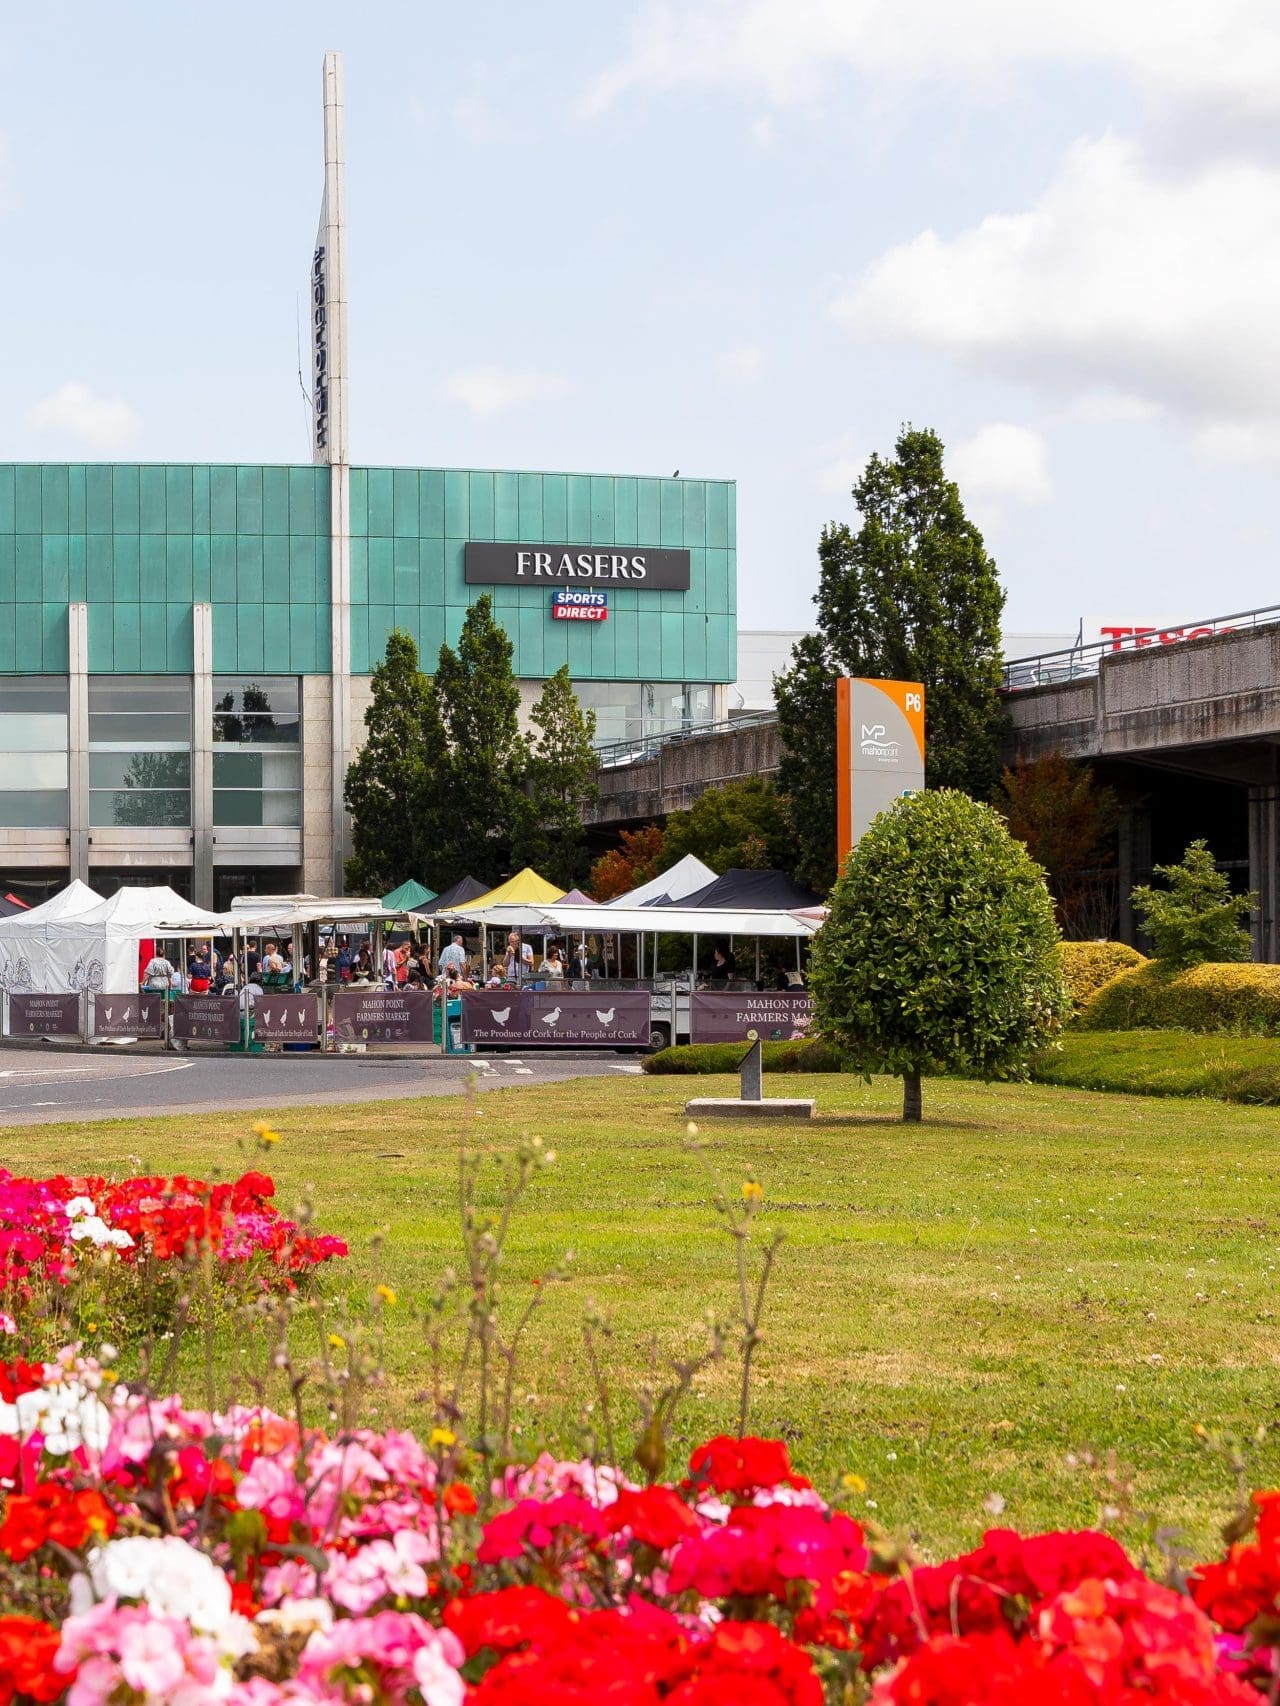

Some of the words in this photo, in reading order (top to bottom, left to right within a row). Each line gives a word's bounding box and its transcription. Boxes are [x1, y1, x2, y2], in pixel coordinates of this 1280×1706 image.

[516, 552, 646, 579] FRASERS
[557, 592, 605, 605] SPORTS
[557, 607, 604, 619] DIRECT
[905, 692, 921, 713] P6
[362, 1000, 384, 1008] MAHON
[386, 1000, 405, 1008] POINT
[747, 1000, 790, 1009] MAHON
[356, 1013, 384, 1021] FARMERS
[385, 1012, 410, 1021] MARKET
[736, 1013, 789, 1022] FARMERS
[474, 1030, 488, 1038] The
[491, 1030, 522, 1038] Produce
[524, 1030, 531, 1038] of
[533, 1030, 551, 1038] Cork
[553, 1030, 565, 1038] for
[566, 1030, 578, 1038] the
[580, 1030, 606, 1040] People
[608, 1030, 616, 1038] of
[618, 1030, 637, 1038] Cork
